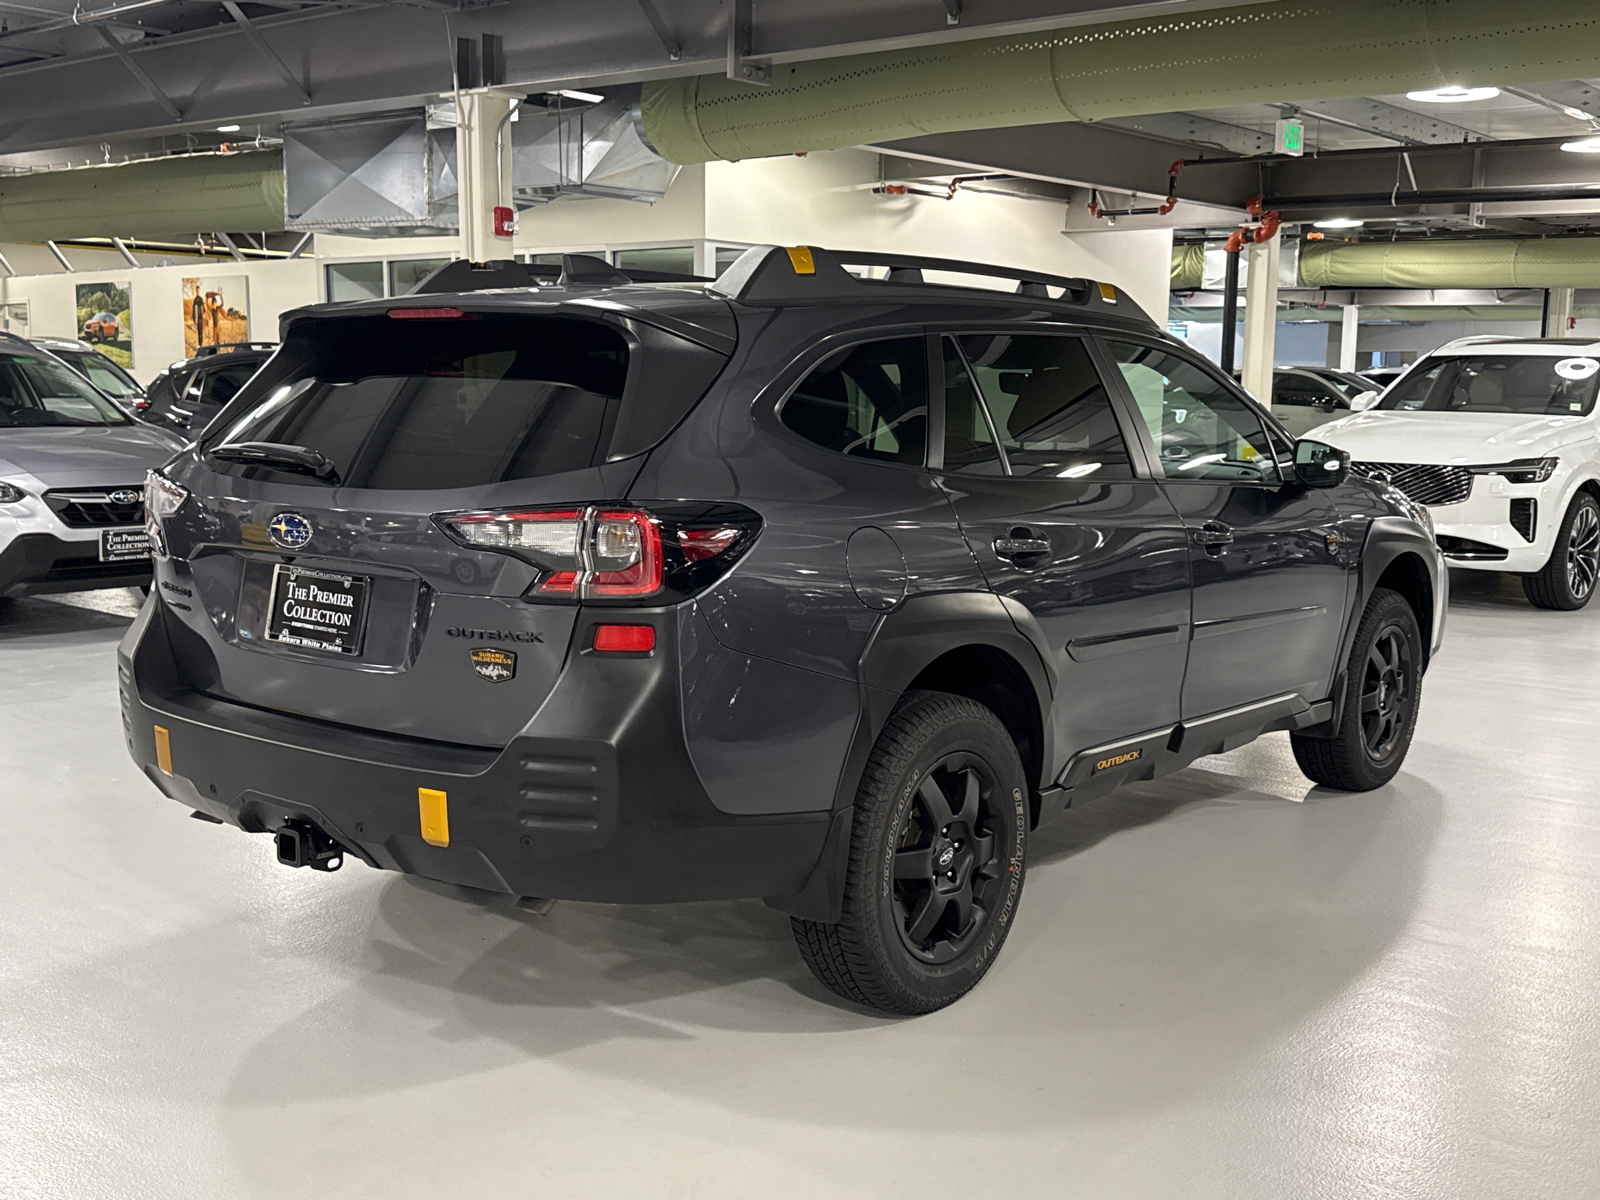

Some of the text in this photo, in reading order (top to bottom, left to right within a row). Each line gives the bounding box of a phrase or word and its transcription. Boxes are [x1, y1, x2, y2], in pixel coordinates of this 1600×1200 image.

[1286, 124, 1301, 150] EXIT
[287, 581, 354, 607] THE PREMIER
[283, 599, 352, 627] COLLECTION
[278, 634, 343, 652] Subaru White Plains
[446, 626, 544, 644] OUTBACK
[471, 656, 512, 664] WILDERNESS
[479, 651, 504, 659] SUBARU
[1097, 750, 1140, 770] OUTBACK
[883, 769, 920, 897] YOKOHAMA
[998, 787, 1026, 927] GEOLANDAR
